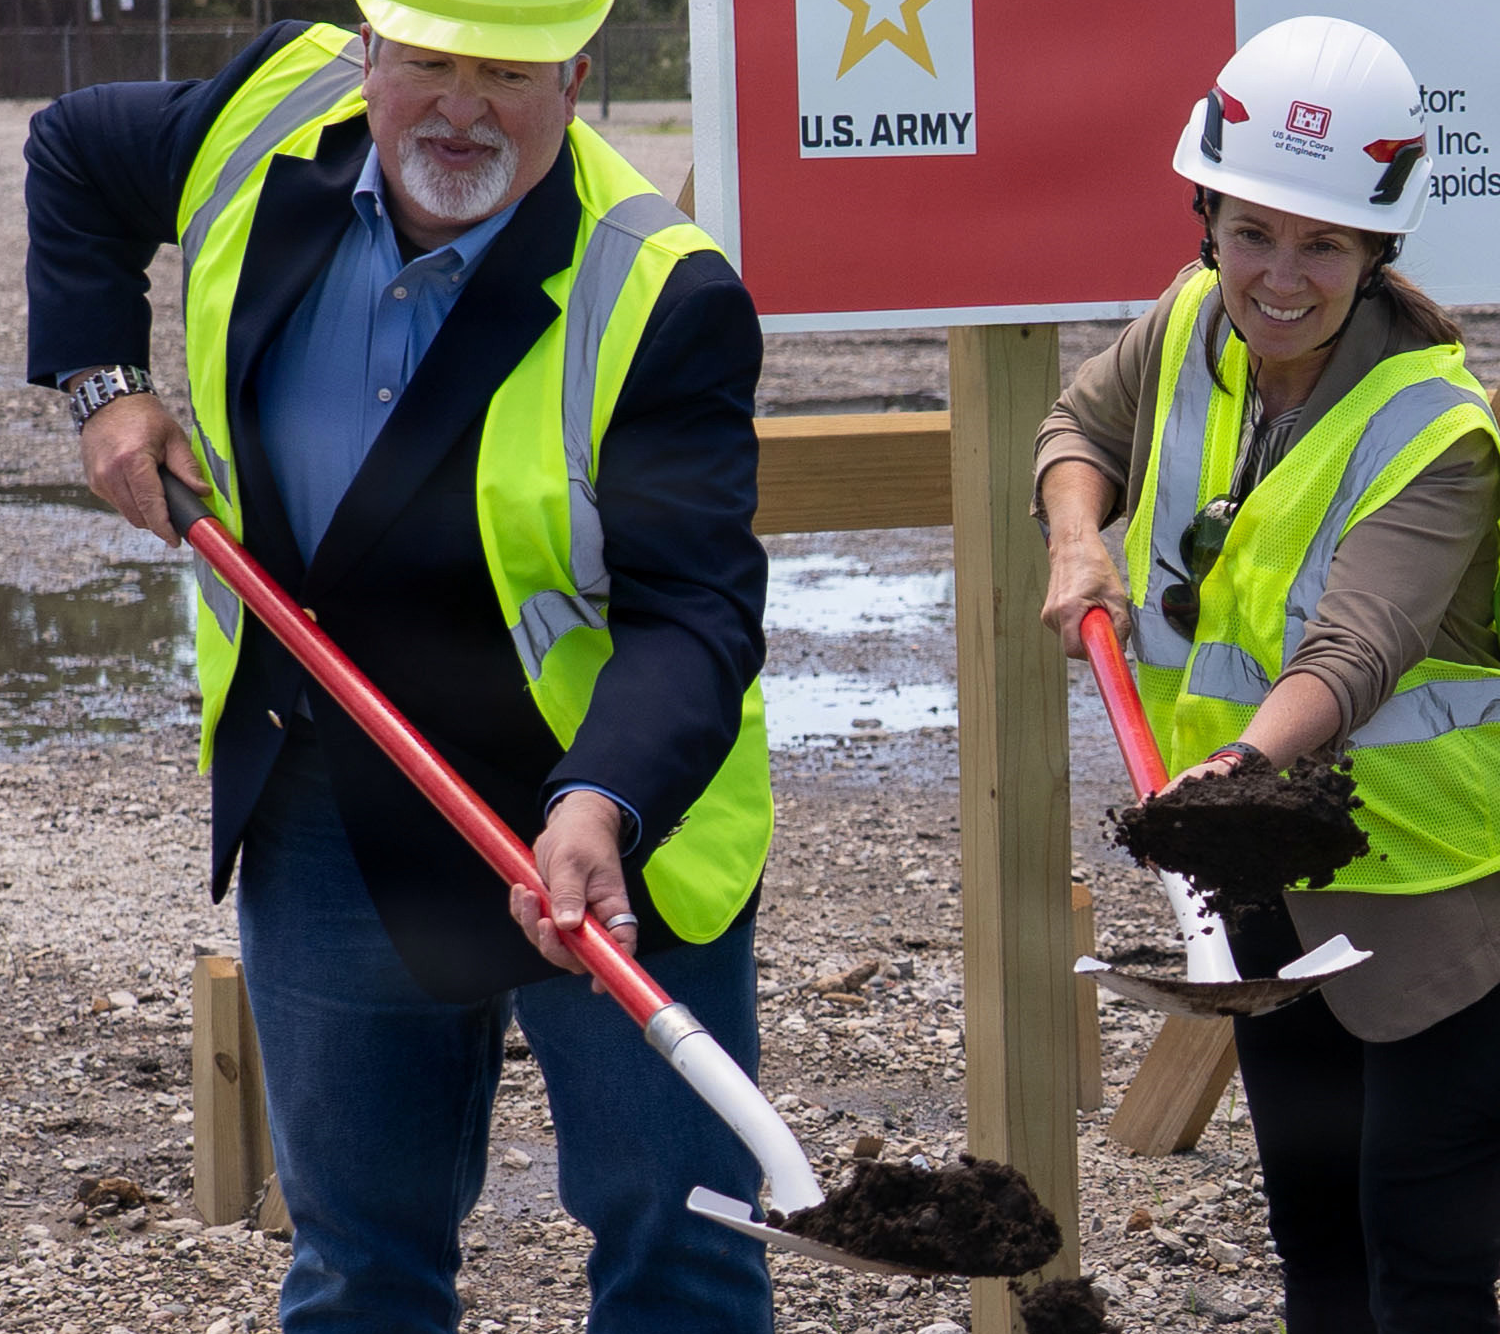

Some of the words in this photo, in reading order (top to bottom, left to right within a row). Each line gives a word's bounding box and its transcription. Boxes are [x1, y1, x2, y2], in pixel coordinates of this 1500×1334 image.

[1418, 84, 1466, 113] tor:
[801, 114, 863, 148] U.S.
[869, 112, 973, 147] ARMY
[1272, 129, 1285, 140] US
[1285, 133, 1308, 147] Army
[1308, 139, 1334, 153] Corps
[1437, 124, 1490, 156] Inc.
[1275, 141, 1285, 149] of
[1285, 143, 1326, 161] Engineers
